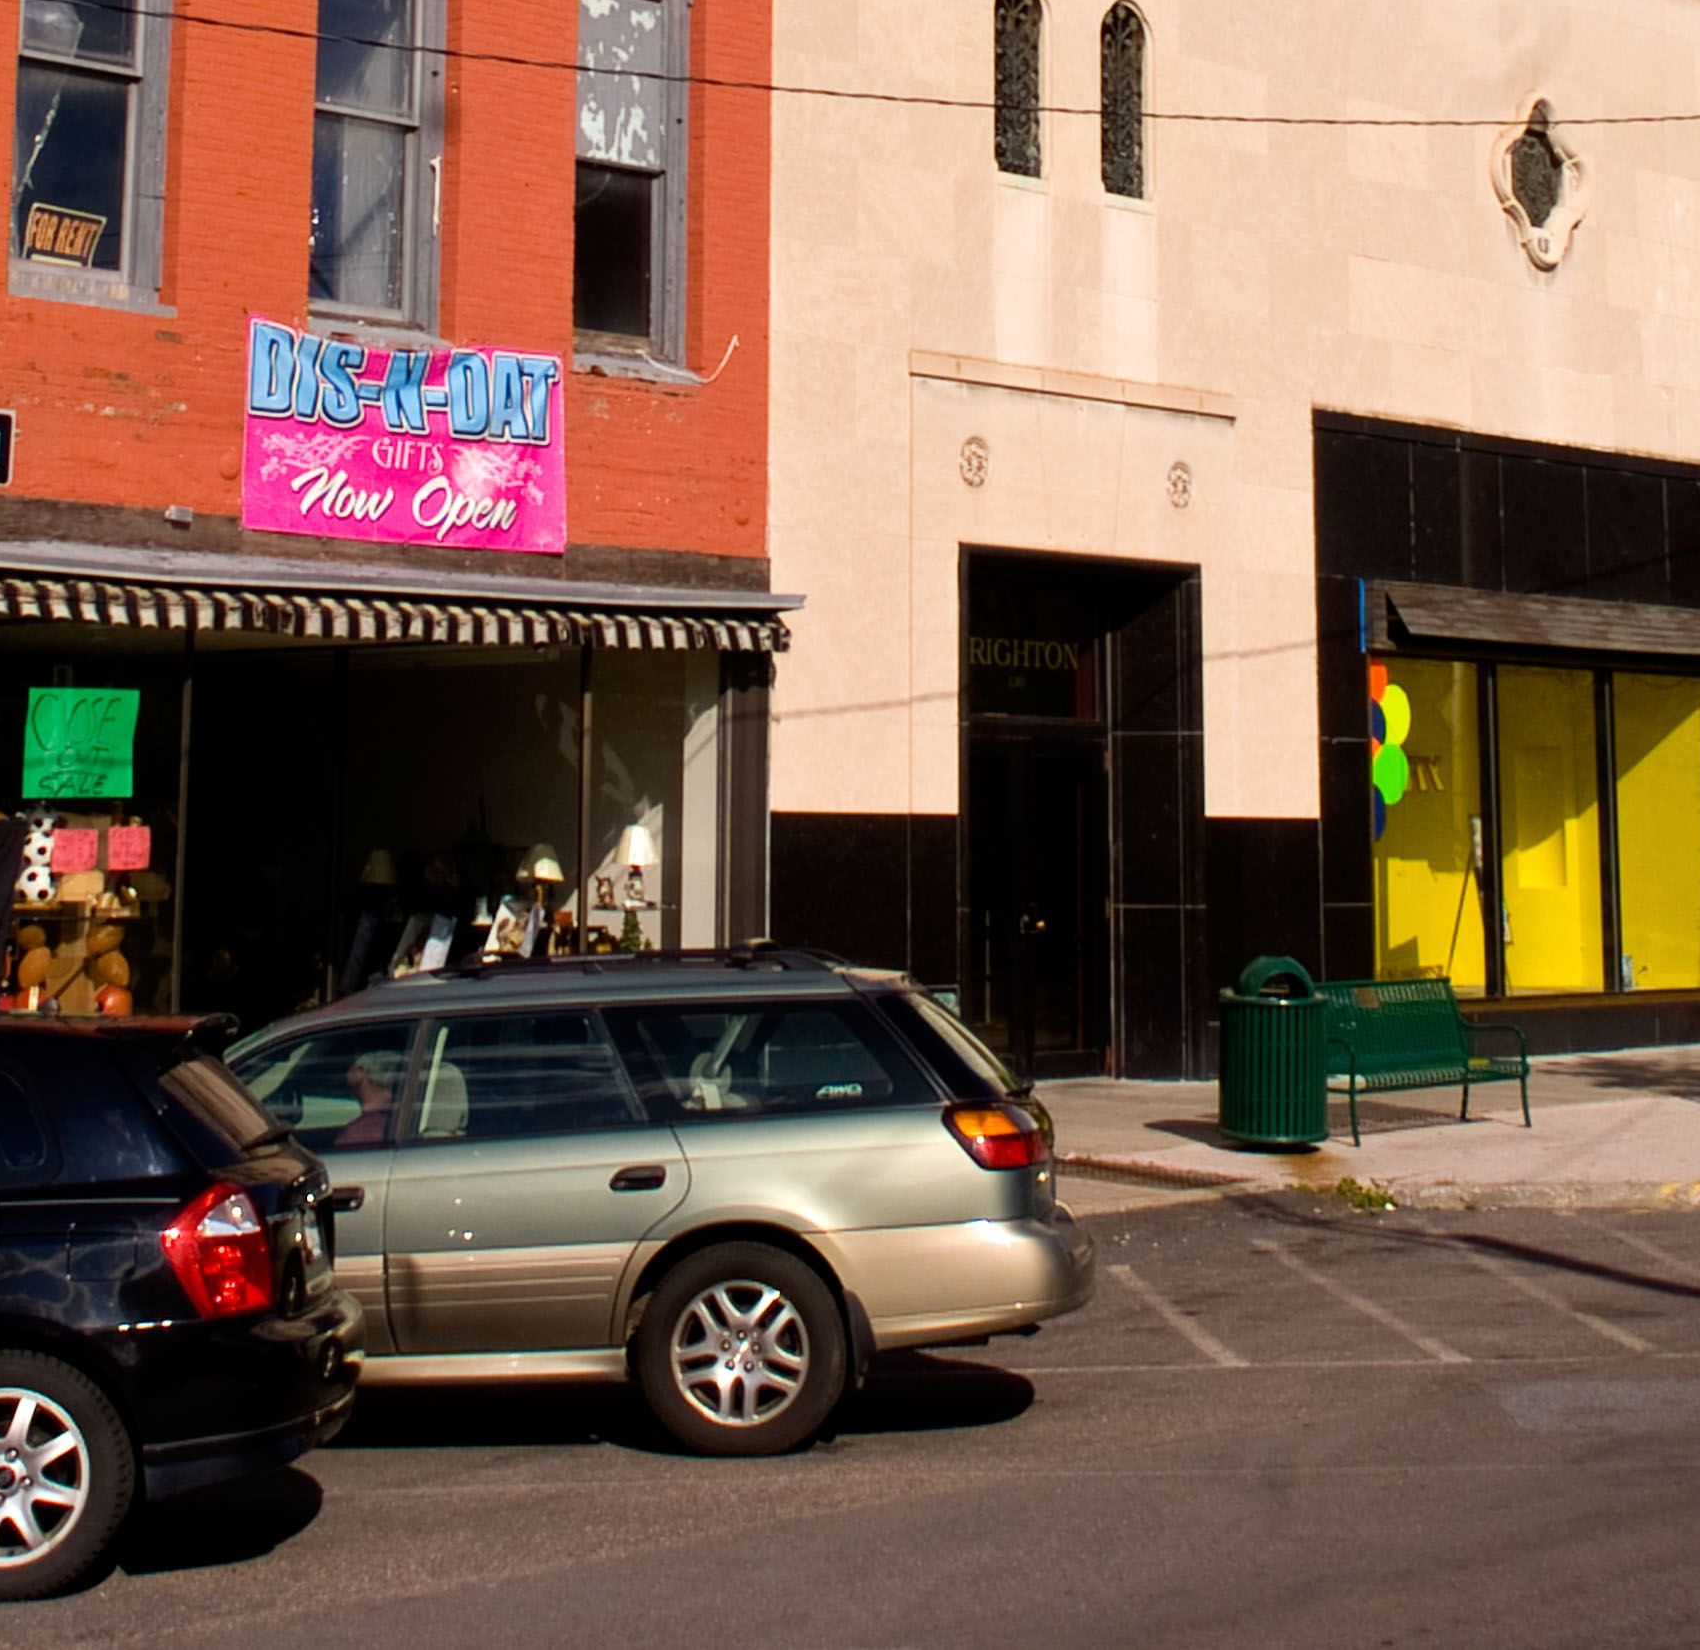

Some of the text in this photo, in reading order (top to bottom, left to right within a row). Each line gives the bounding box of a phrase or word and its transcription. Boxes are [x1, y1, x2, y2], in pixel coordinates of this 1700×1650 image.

[27, 211, 99, 258] FOR RENT
[249, 318, 558, 445] DIS-N-DAT
[371, 436, 444, 475] GIFTS
[290, 466, 519, 542] Now Open
[969, 636, 1079, 670] RIGHTON
[38, 774, 108, 796] SALE
